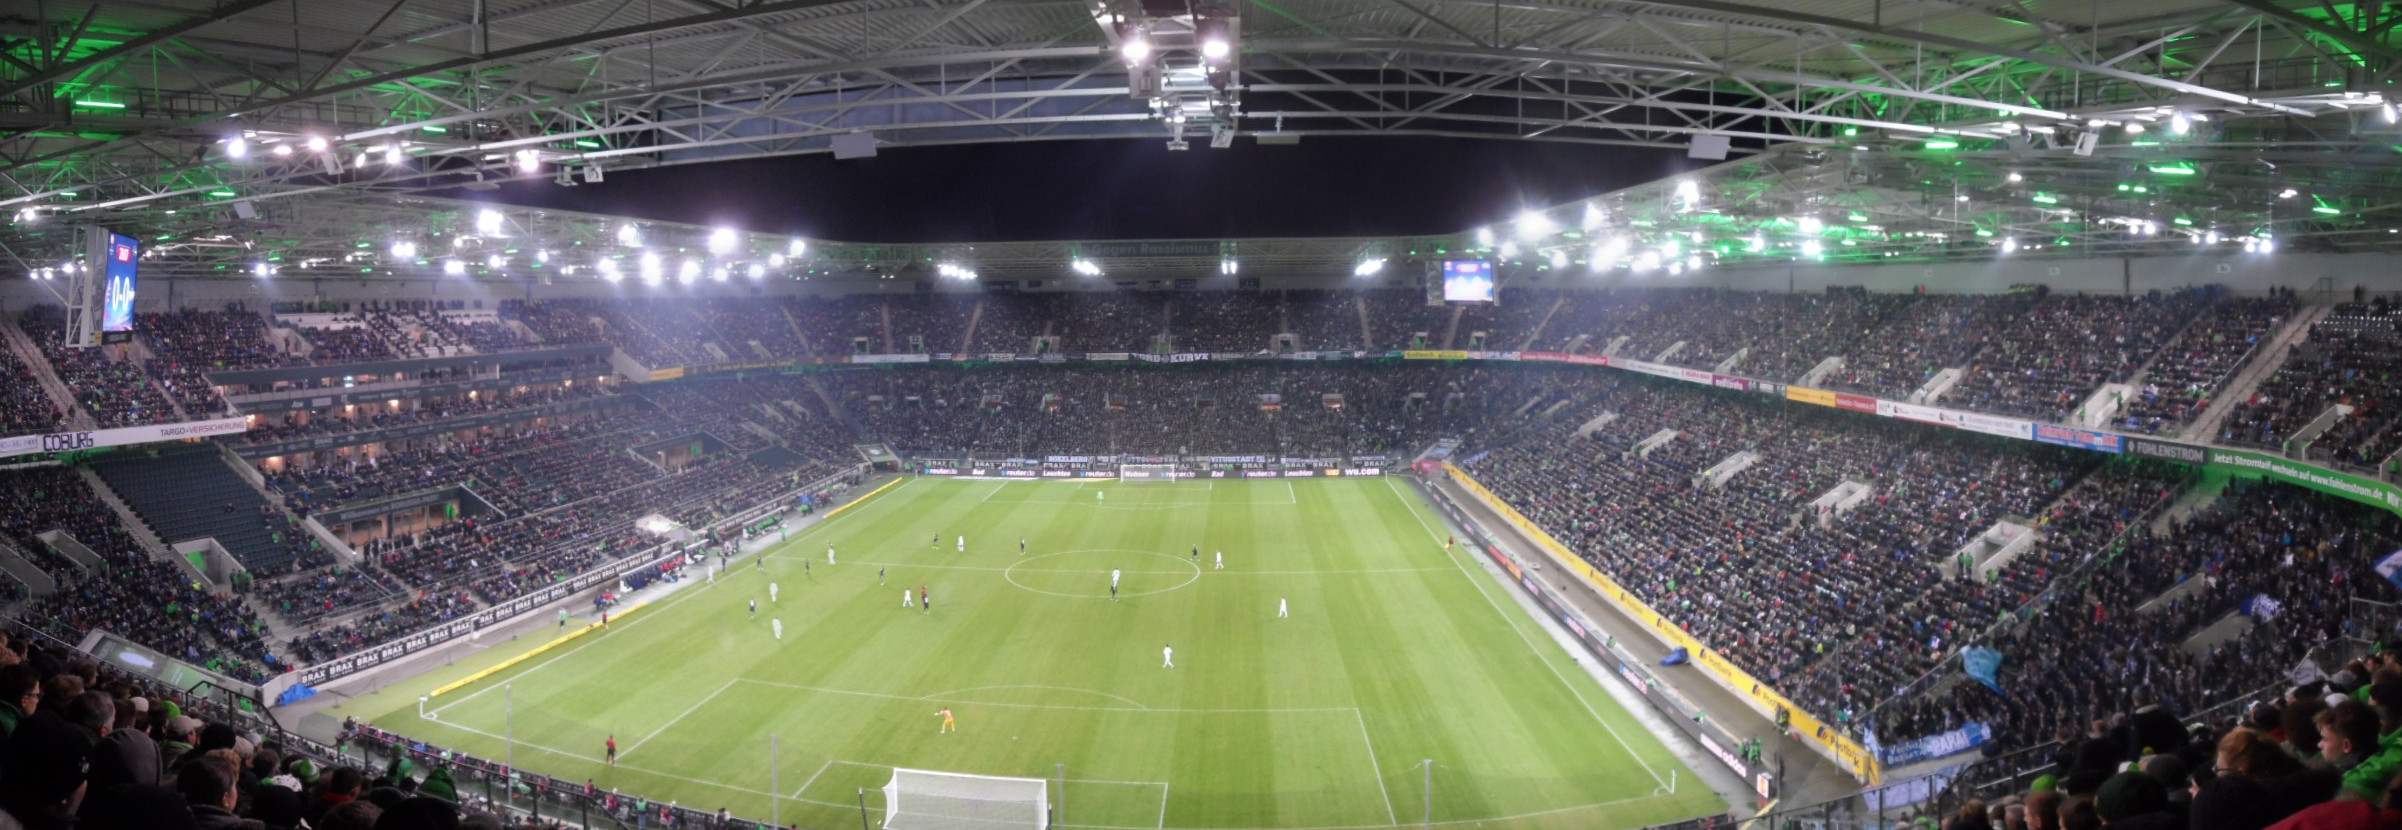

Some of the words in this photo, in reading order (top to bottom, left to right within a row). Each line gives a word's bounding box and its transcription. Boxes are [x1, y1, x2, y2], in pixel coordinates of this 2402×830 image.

[43, 431, 93, 451] COBURG
[2137, 441, 2203, 462] FOHLENSTROM
[2214, 453, 2232, 463] Jetzt
[496, 607, 513, 617] BRAX
[452, 623, 470, 634] BRAX
[430, 629, 449, 642] BRAX
[406, 636, 427, 649] BRAX
[382, 644, 404, 657] BRAX
[357, 653, 379, 666] BRAX
[330, 661, 353, 675] BRAX
[302, 670, 325, 683] BRAX
